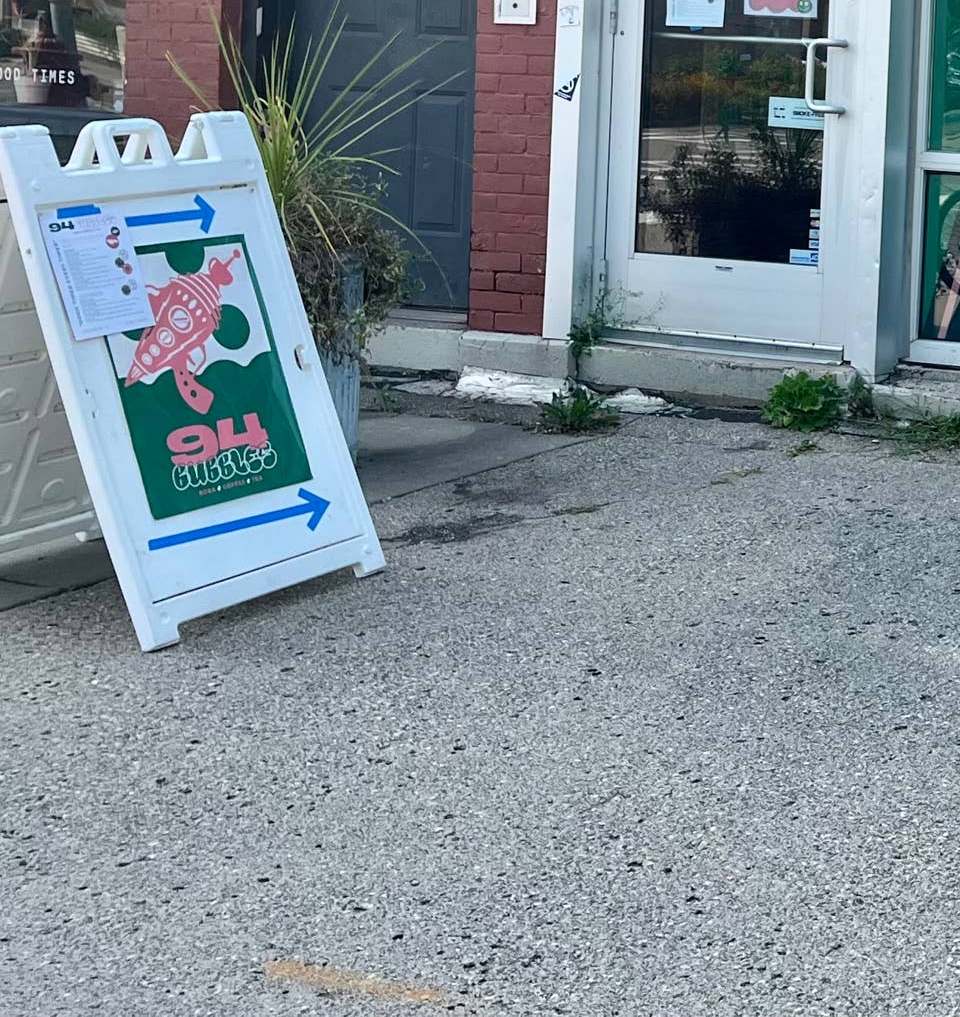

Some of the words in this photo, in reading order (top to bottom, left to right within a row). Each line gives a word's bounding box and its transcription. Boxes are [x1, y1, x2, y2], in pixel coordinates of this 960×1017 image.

[31, 68, 75, 84] TIMES
[48, 220, 75, 233] 94
[166, 412, 269, 467] 94
[172, 440, 278, 491] BUBBLES
